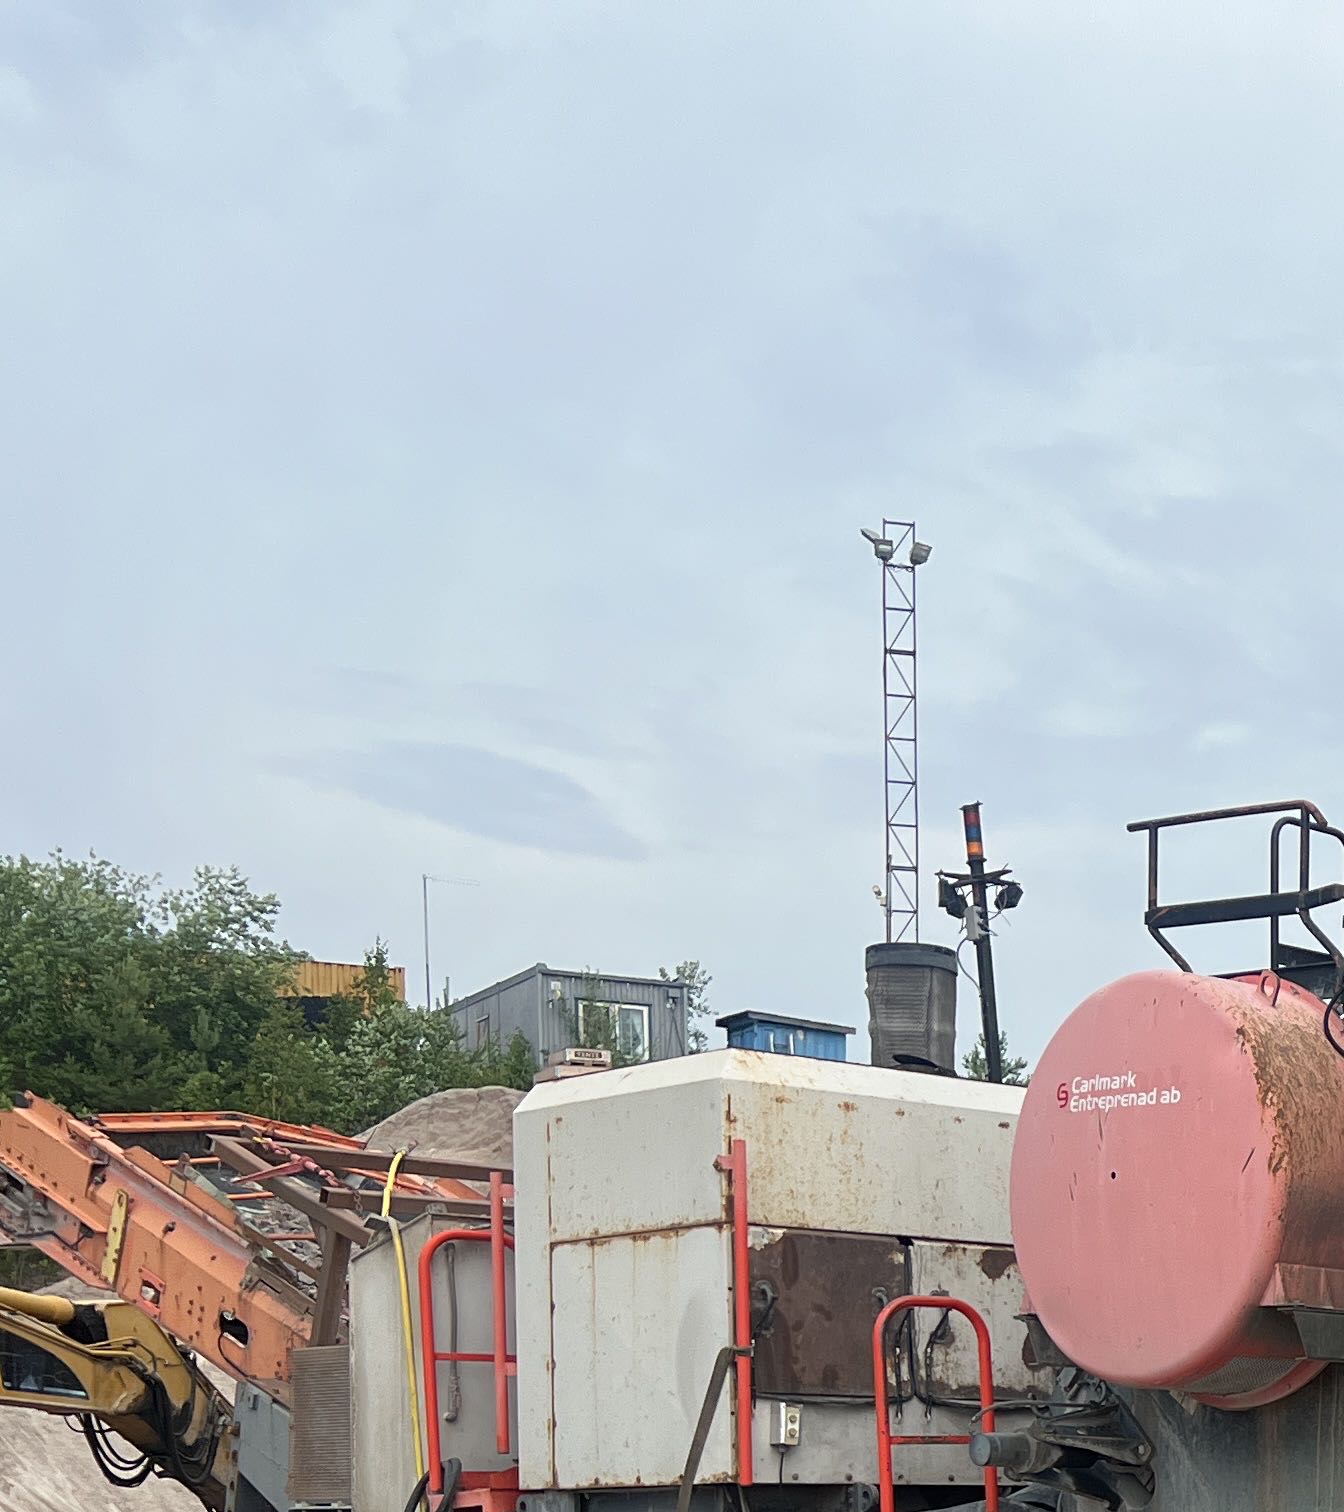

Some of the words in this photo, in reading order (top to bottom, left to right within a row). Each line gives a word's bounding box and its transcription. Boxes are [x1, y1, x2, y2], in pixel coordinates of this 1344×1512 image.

[1071, 1071, 1136, 1093] Carlmark
[1070, 1087, 1157, 1112] Entreprenad
[1160, 1086, 1180, 1103] ab
